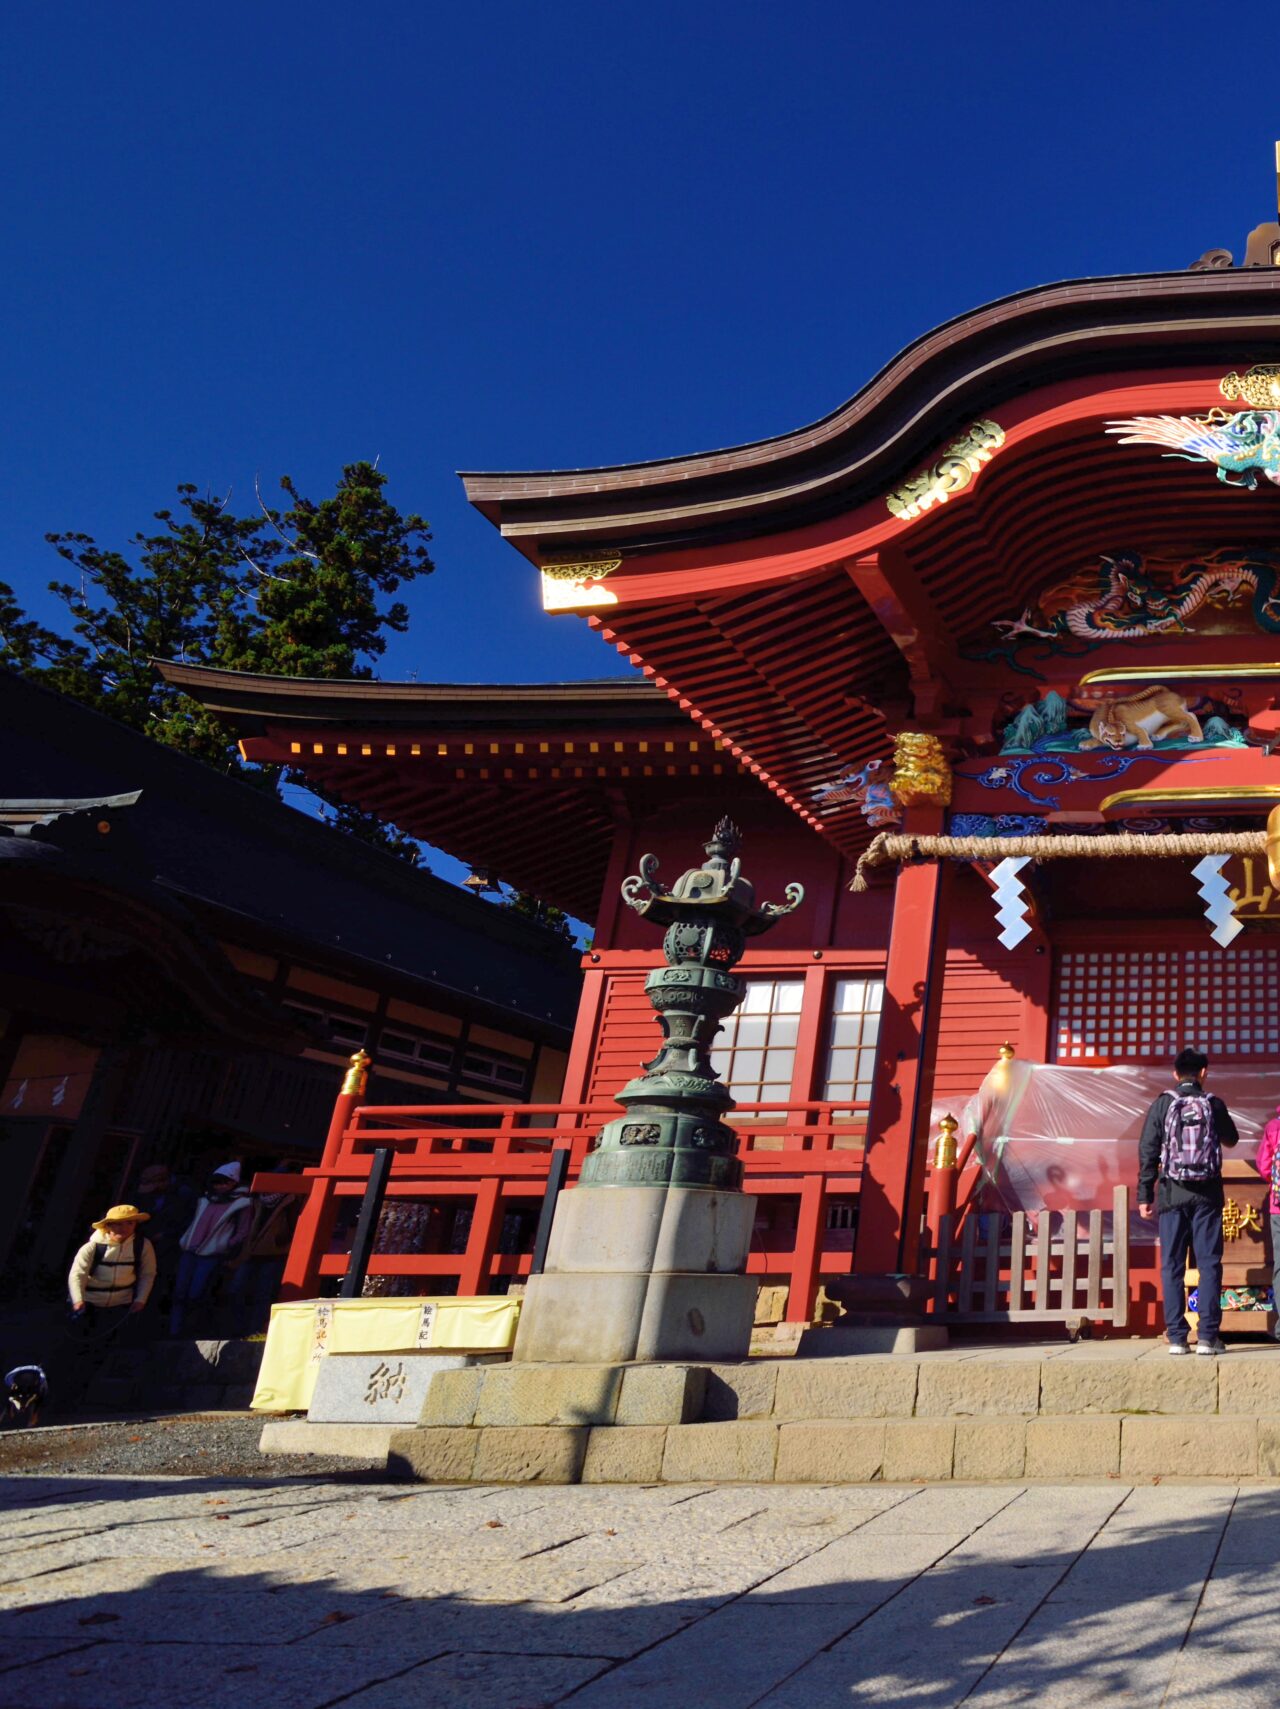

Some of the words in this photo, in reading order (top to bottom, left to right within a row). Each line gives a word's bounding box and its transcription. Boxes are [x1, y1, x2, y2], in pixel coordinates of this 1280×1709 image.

[418, 1305, 433, 1350] 絵馬記
[363, 1362, 406, 1405] 納
